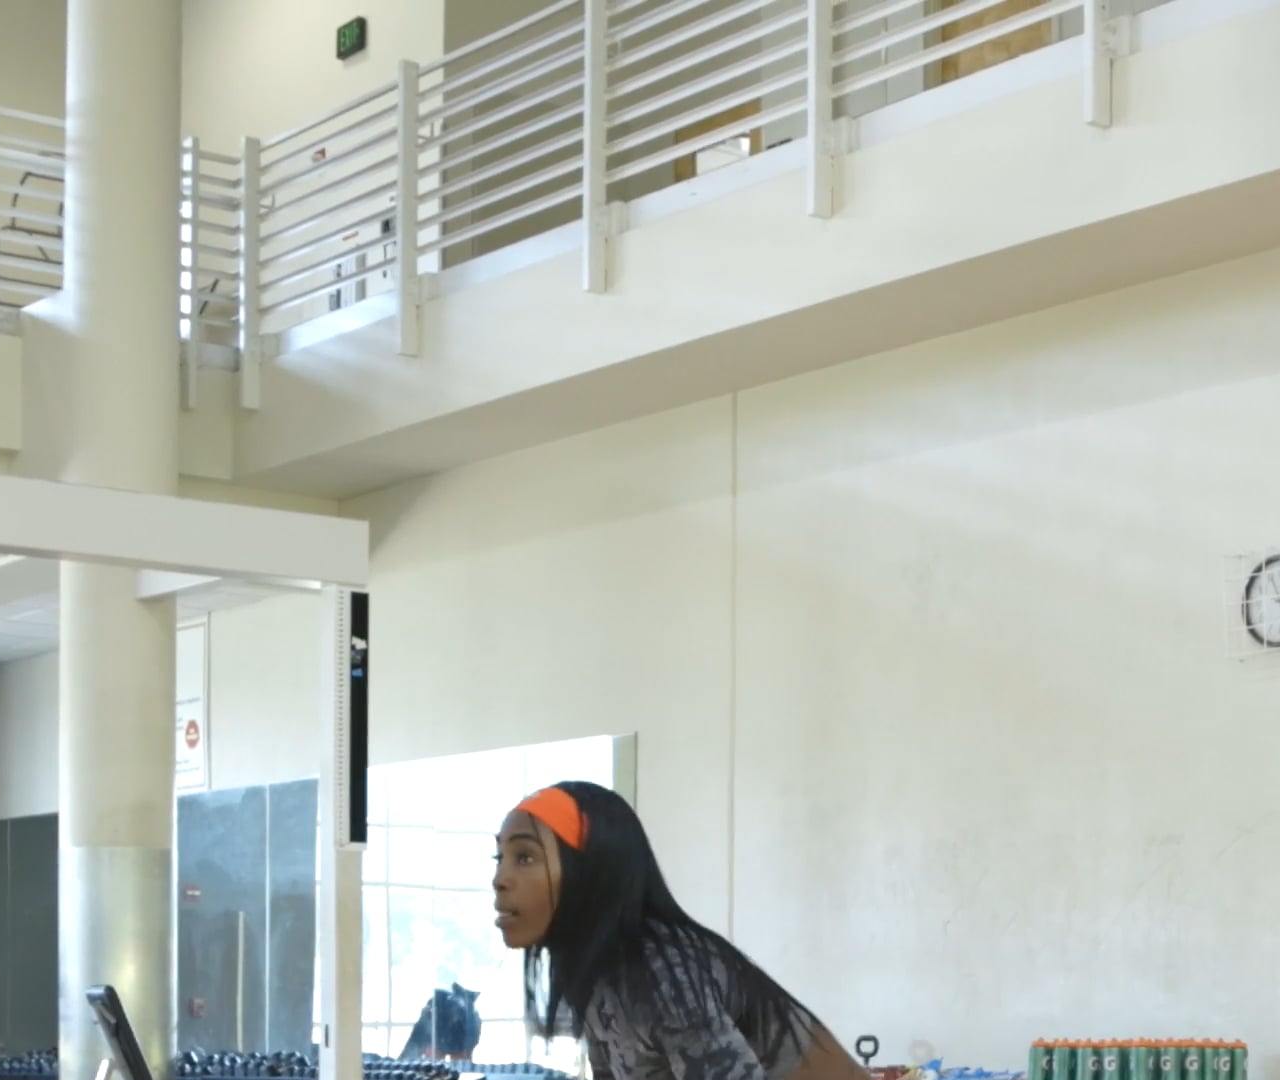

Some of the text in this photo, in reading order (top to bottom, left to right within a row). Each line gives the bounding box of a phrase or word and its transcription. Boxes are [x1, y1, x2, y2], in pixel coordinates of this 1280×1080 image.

[1160, 1055, 1172, 1071] G
[1185, 1055, 1199, 1071] G
[1218, 1056, 1231, 1072] G
